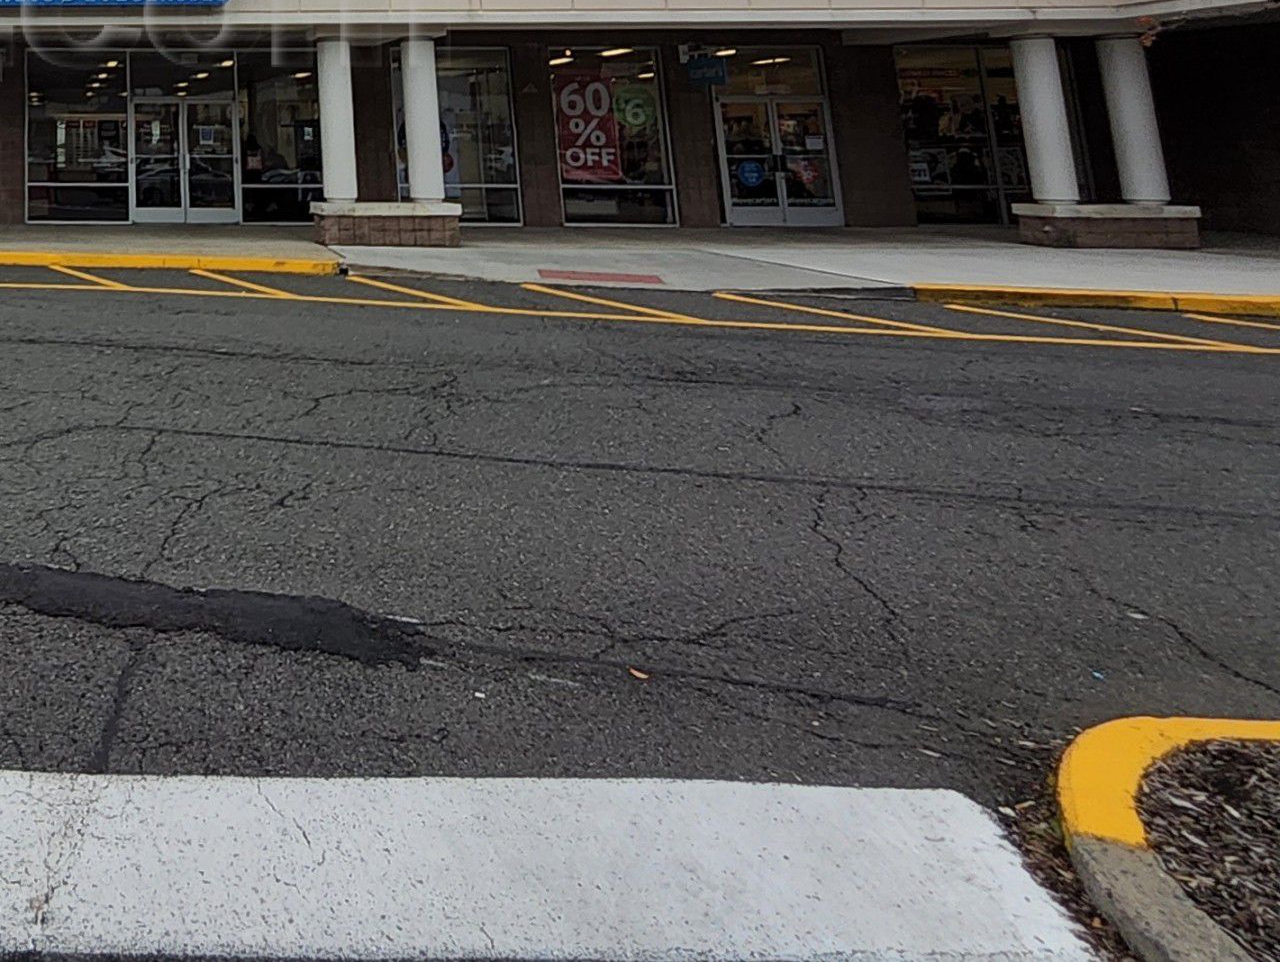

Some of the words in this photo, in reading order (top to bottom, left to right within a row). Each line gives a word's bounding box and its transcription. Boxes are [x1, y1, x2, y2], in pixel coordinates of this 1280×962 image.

[560, 81, 611, 118] 60
[569, 118, 607, 146] %
[565, 147, 616, 168] OFF
